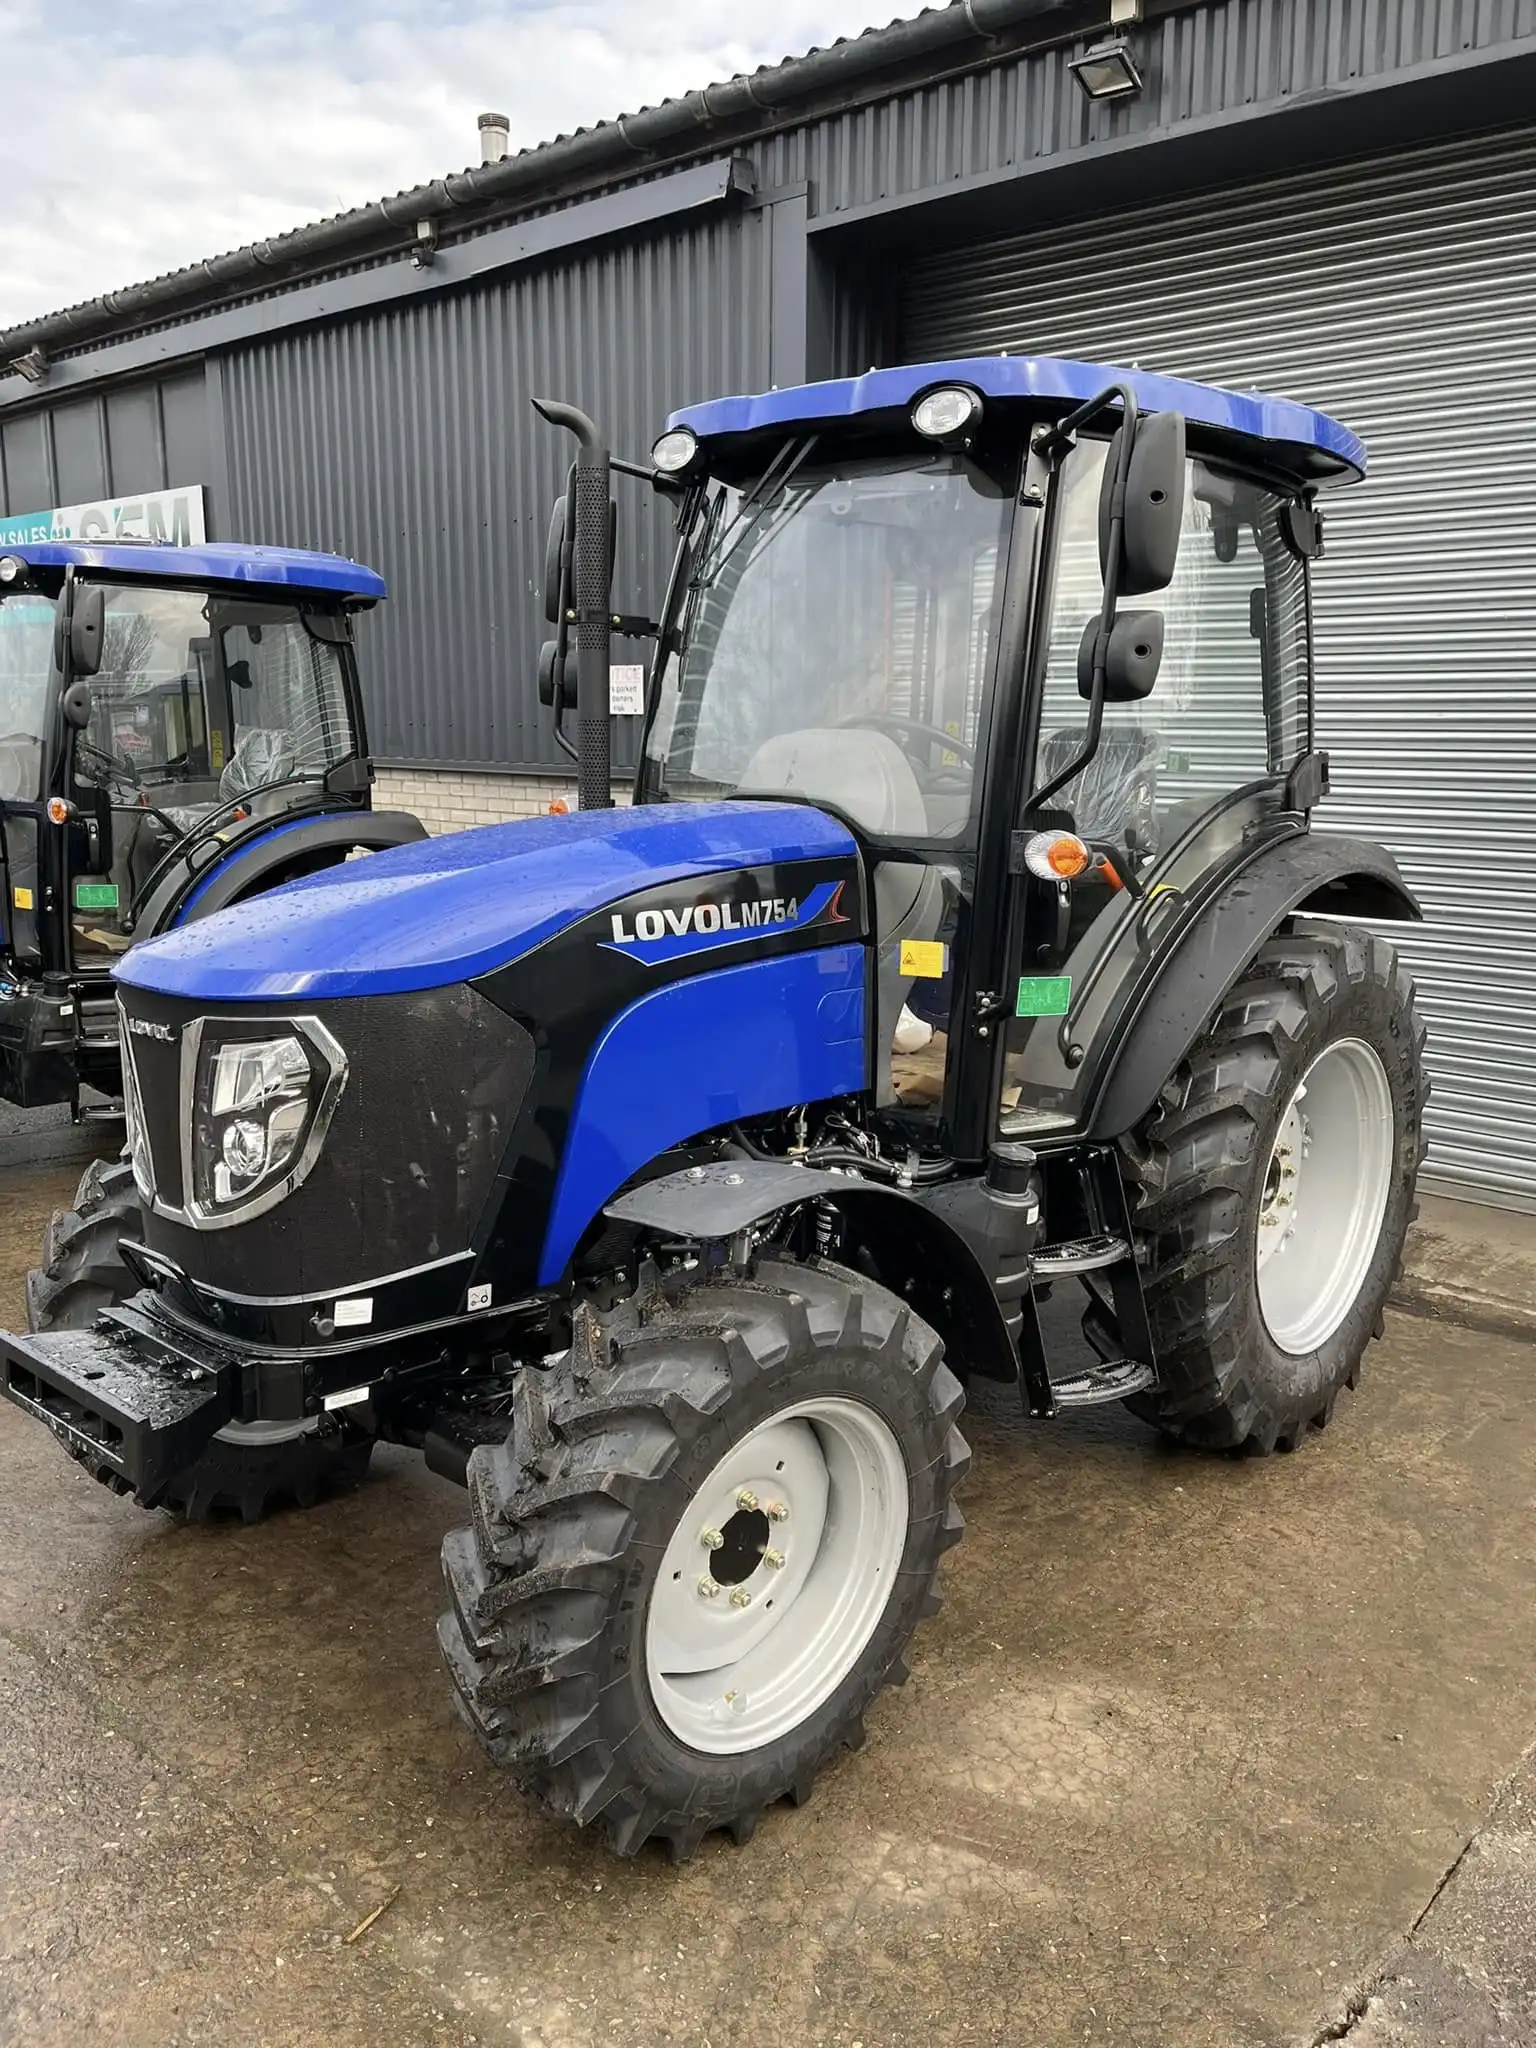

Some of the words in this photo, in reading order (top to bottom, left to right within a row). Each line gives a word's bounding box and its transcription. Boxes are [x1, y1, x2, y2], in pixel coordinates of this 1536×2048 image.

[9, 525, 47, 544] SALES
[611, 903, 741, 944] LOVOL
[741, 897, 799, 928] M754
